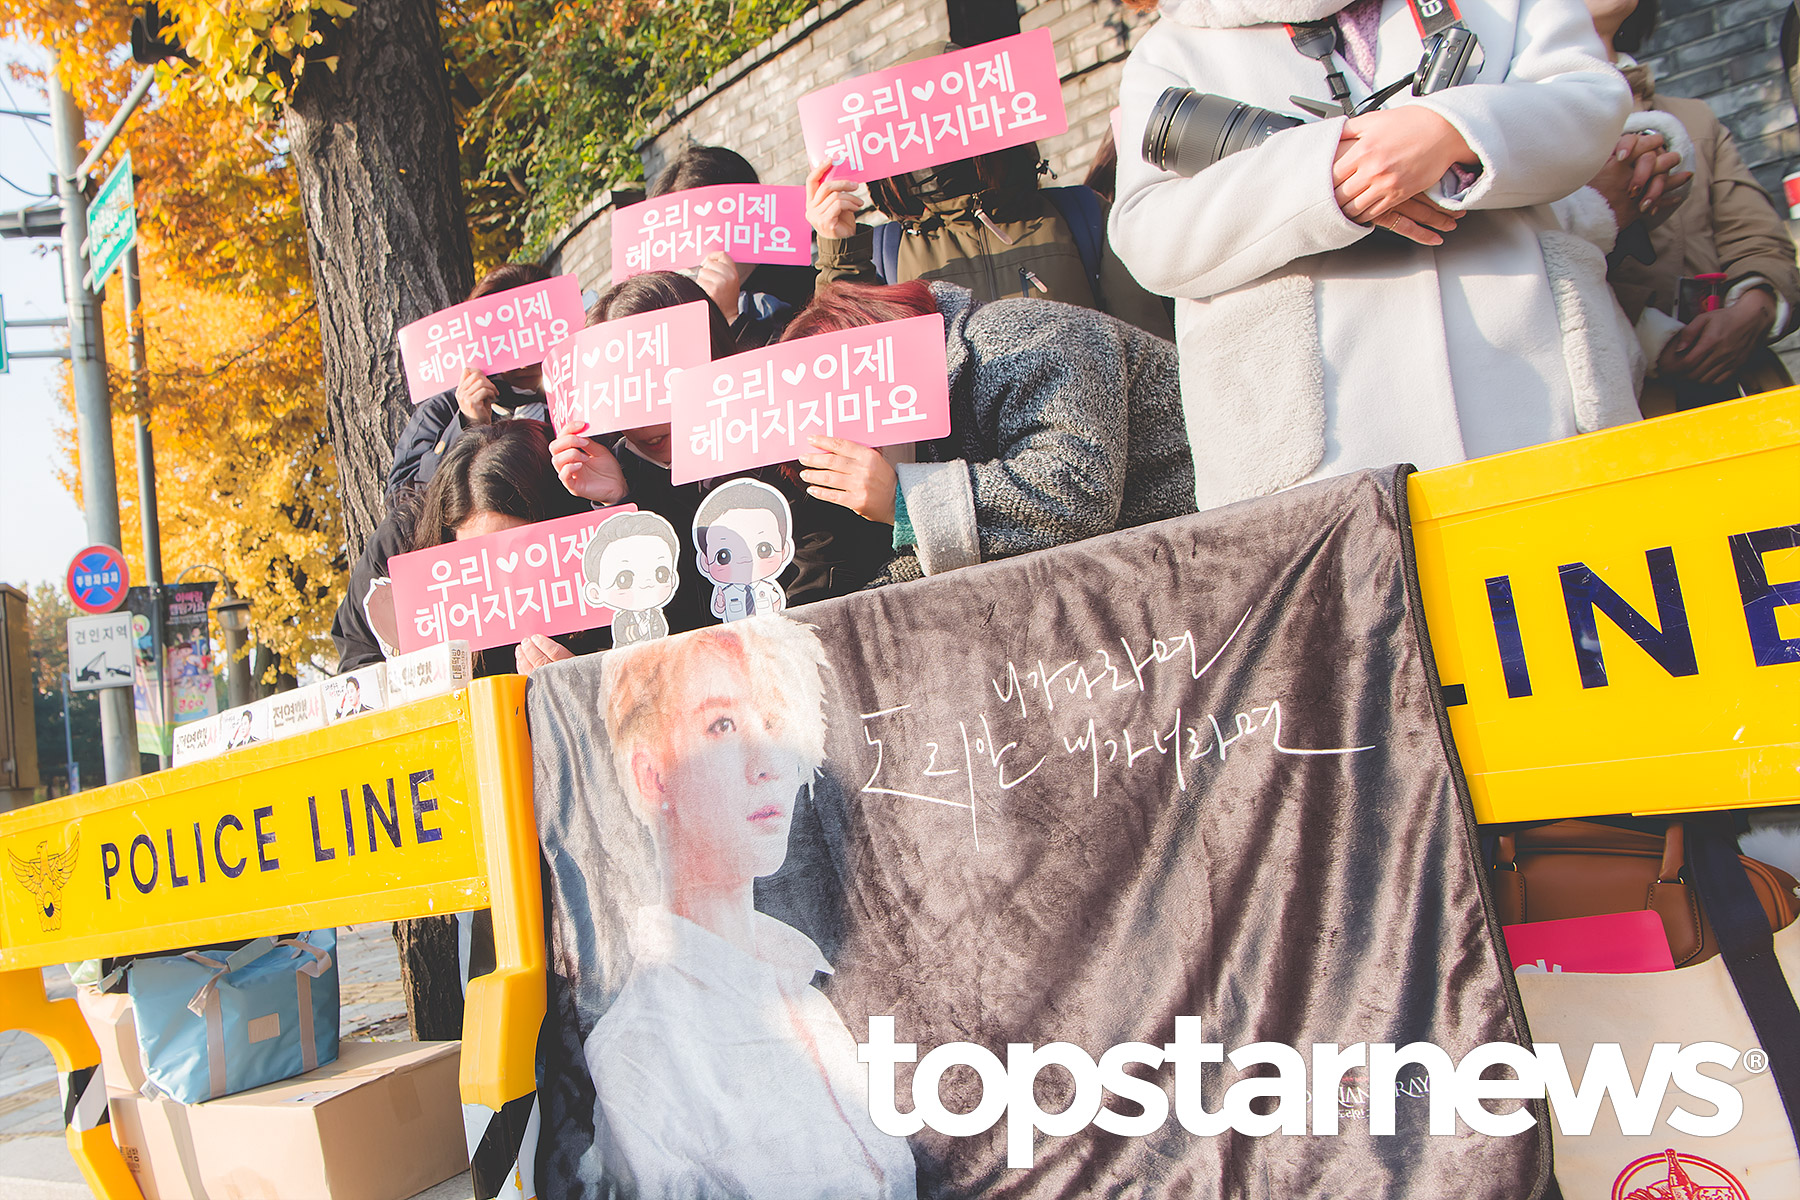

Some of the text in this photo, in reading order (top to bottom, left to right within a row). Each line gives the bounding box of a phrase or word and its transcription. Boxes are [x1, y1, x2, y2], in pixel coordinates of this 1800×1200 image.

[837, 51, 1016, 132] 우리 이제
[824, 91, 1047, 171] 헤어지지마요
[625, 221, 796, 271] 헤어지지마요
[638, 193, 777, 240] 우리 이제
[418, 319, 569, 383] 헤어지지마요
[425, 290, 553, 353] 우리 이제
[552, 322, 669, 391] 우리 이제
[706, 336, 895, 418] 우리 이제
[689, 385, 928, 462] 헤어지지마요
[426, 548, 493, 603] 우리
[1440, 523, 1800, 708] INE
[100, 768, 443, 900] POLICE LINE
